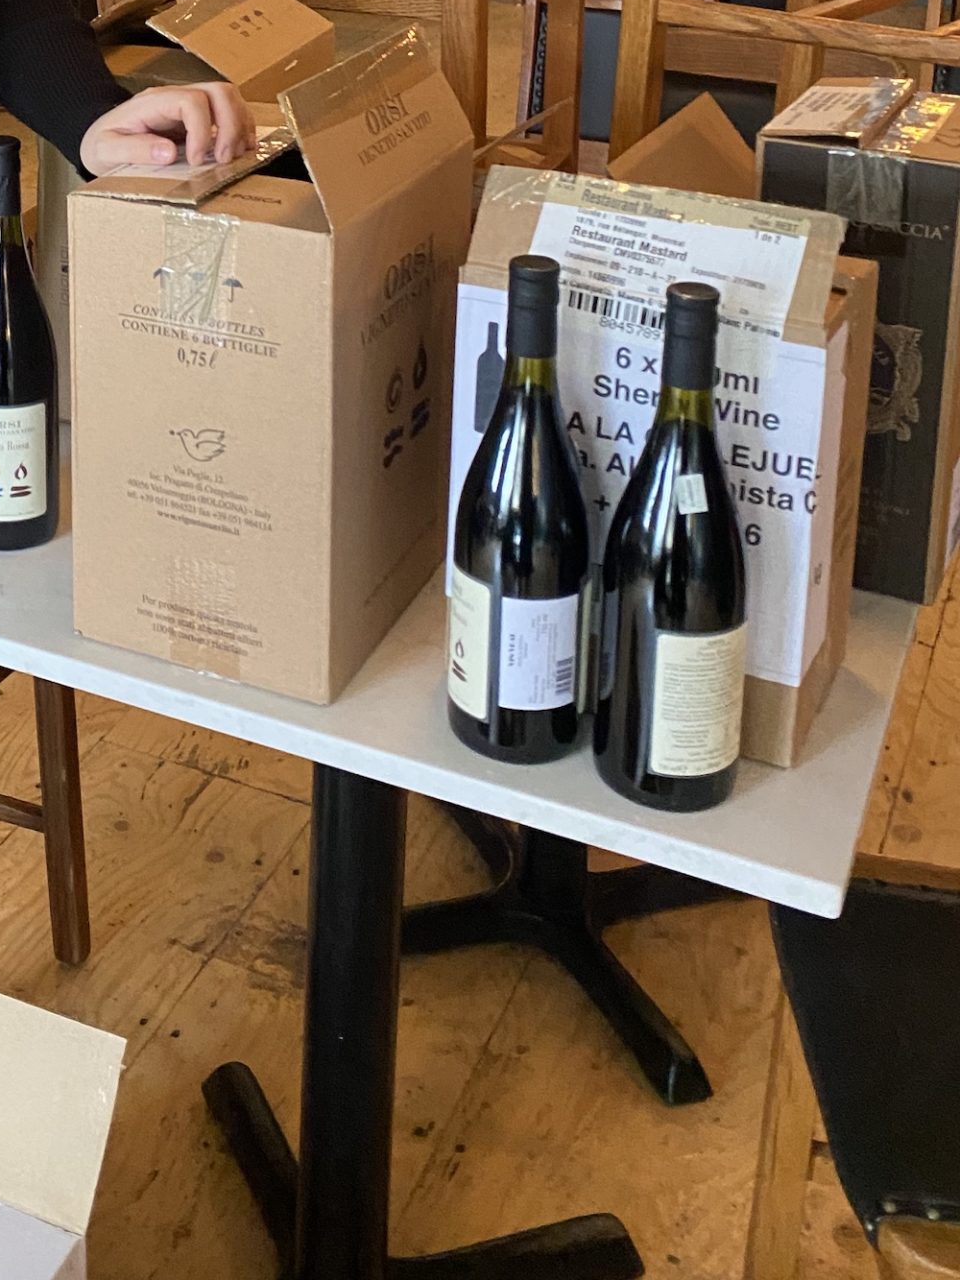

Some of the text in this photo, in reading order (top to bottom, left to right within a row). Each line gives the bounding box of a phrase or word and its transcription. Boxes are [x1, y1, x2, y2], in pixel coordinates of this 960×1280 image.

[365, 93, 409, 135] ORSI
[571, 224, 689, 263] Restaurant Mastard
[121, 319, 279, 359] CONTIENE 6 BOTTIGLIE
[616, 346, 632, 369] 6
[641, 356, 658, 375] x
[596, 416, 635, 445] LA
